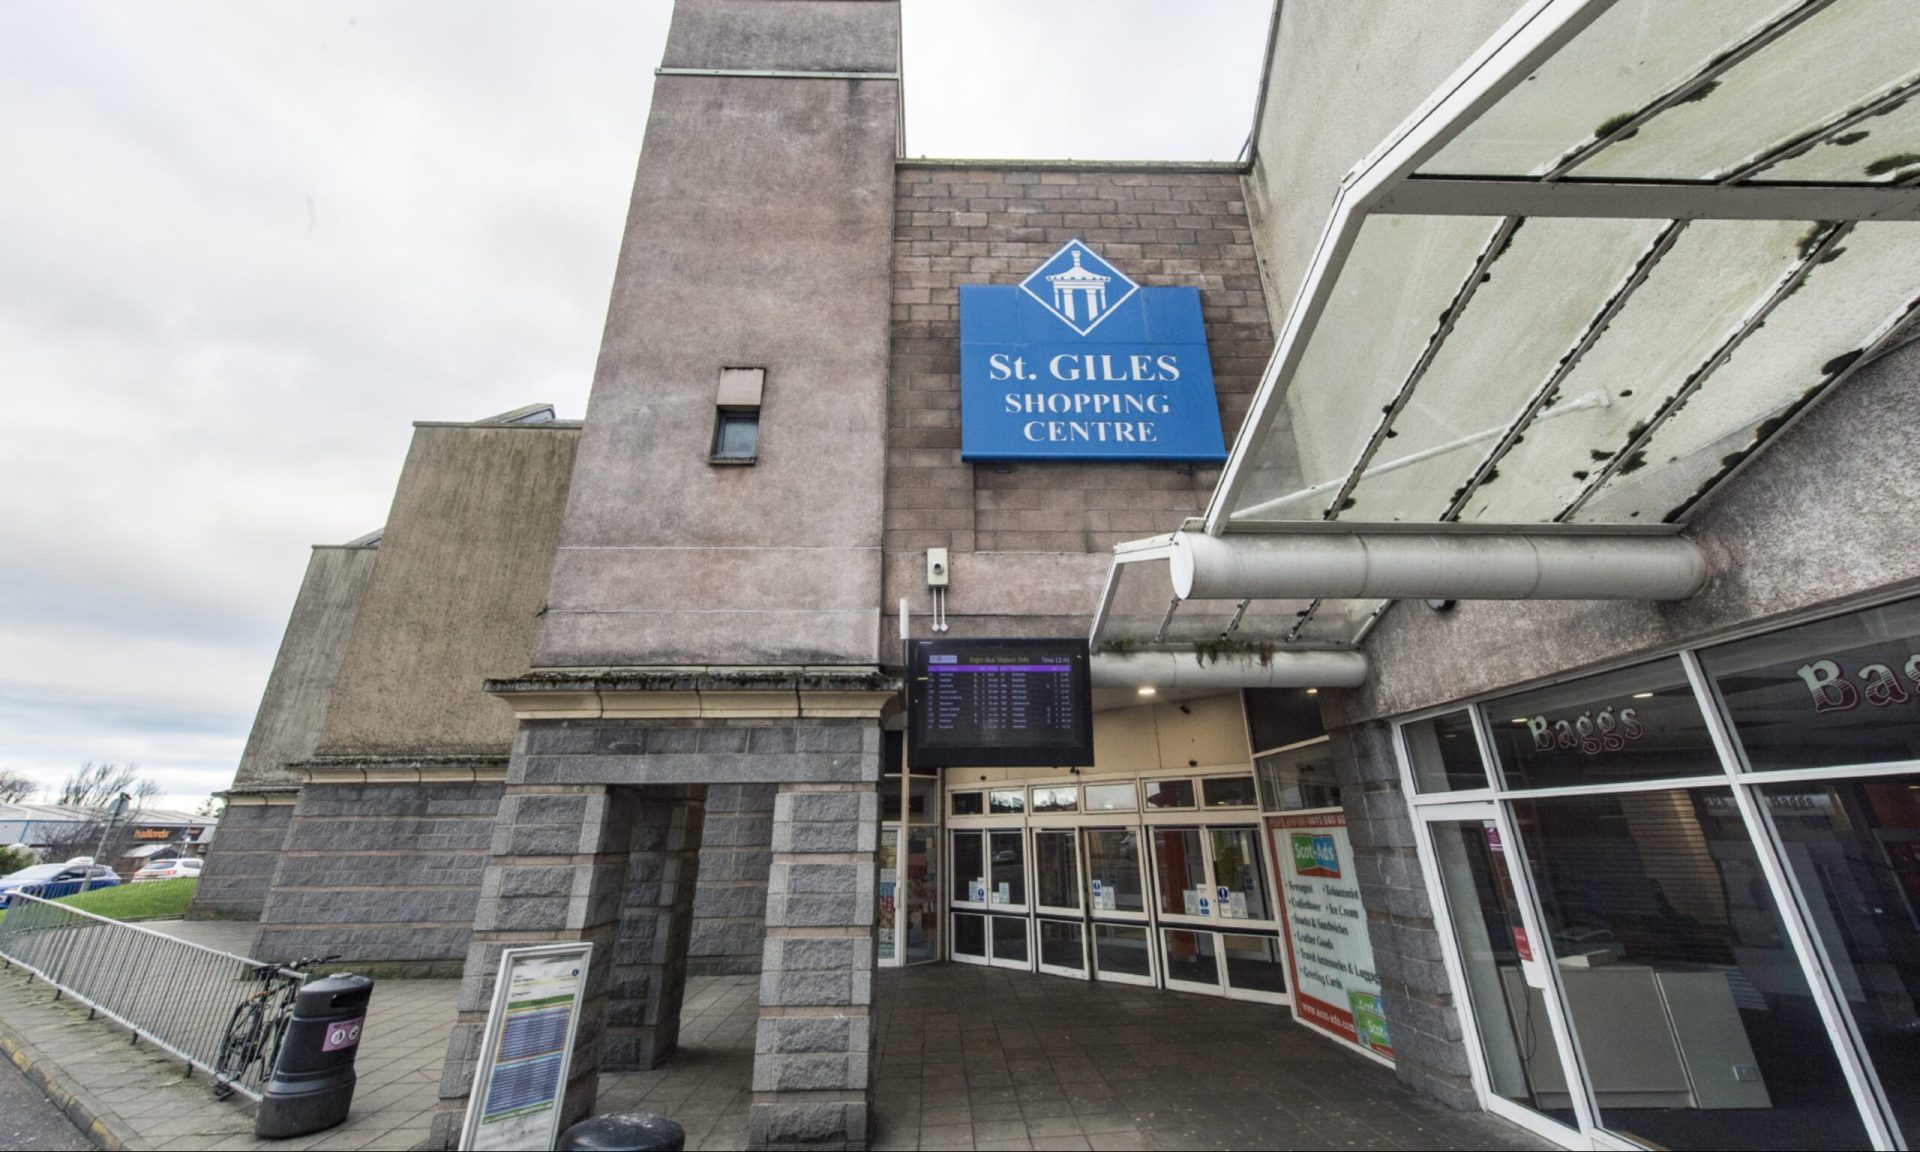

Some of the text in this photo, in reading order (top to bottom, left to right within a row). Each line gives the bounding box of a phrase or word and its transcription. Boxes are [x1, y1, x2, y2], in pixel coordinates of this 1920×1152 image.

[989, 353, 1181, 382] St. GILES
[1005, 392, 1171, 414] SHOPPING
[1023, 420, 1158, 442] CENTRE
[1527, 705, 1644, 755] Baggs
[134, 828, 169, 839] halfords
[1329, 903, 1359, 919] Ice Cream
[1297, 930, 1316, 945] Leather
[1318, 918, 1349, 935] Sandwiches
[1303, 966, 1343, 989] Greeting Cards
